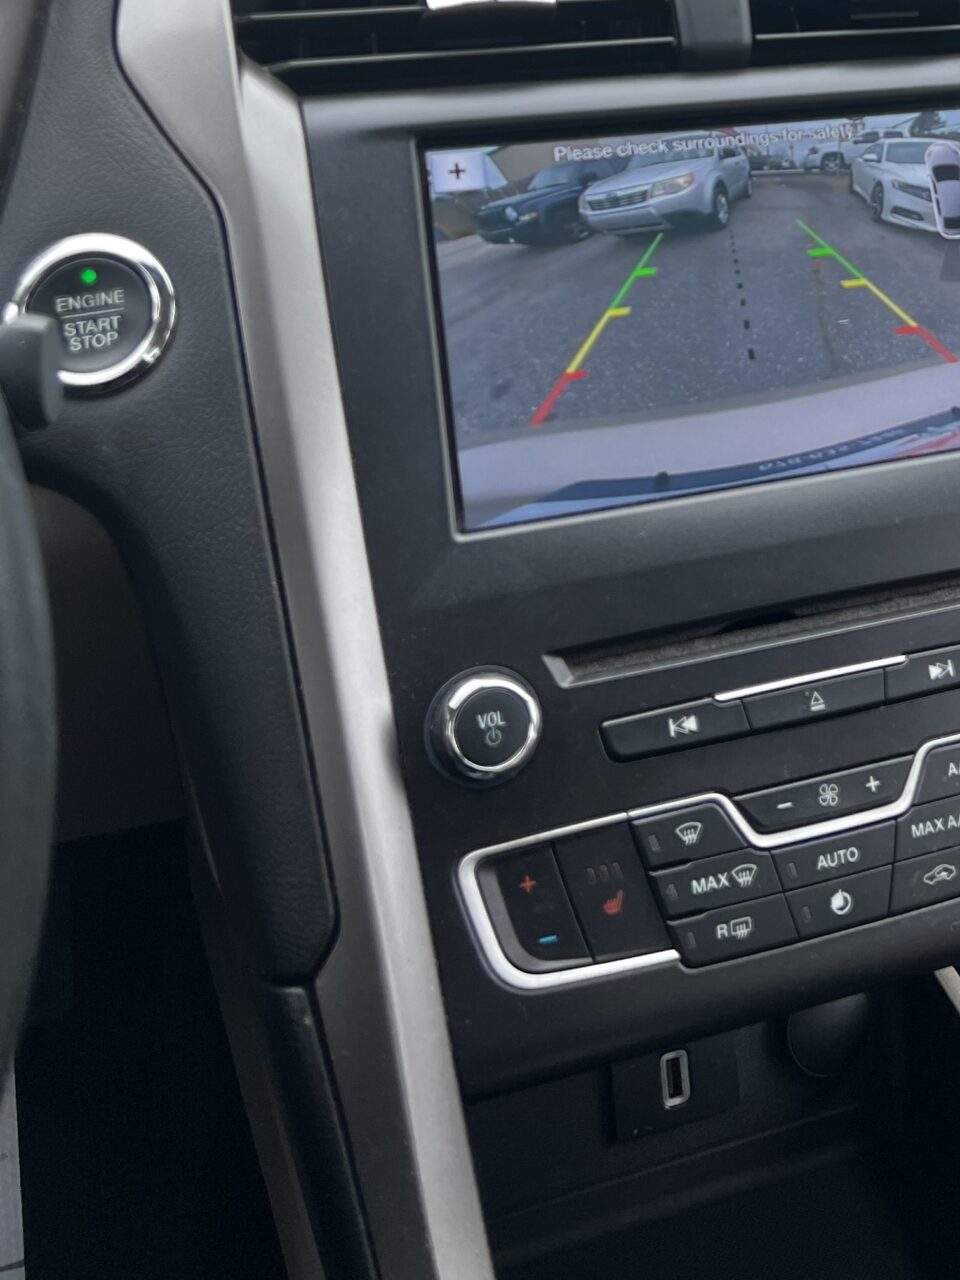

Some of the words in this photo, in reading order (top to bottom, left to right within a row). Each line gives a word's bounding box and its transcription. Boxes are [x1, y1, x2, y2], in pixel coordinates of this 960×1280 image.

[552, 145, 613, 162] Please
[616, 138, 669, 158] check
[672, 129, 778, 152] surroundings
[781, 129, 804, 143] for
[55, 289, 125, 312] ENGINE
[63, 315, 121, 337] START
[69, 331, 118, 351] STOP
[477, 710, 507, 729] VOL
[911, 819, 945, 838] MAX
[817, 846, 859, 870] AUTO
[691, 872, 730, 895] MAX
[716, 923, 729, 939] R
